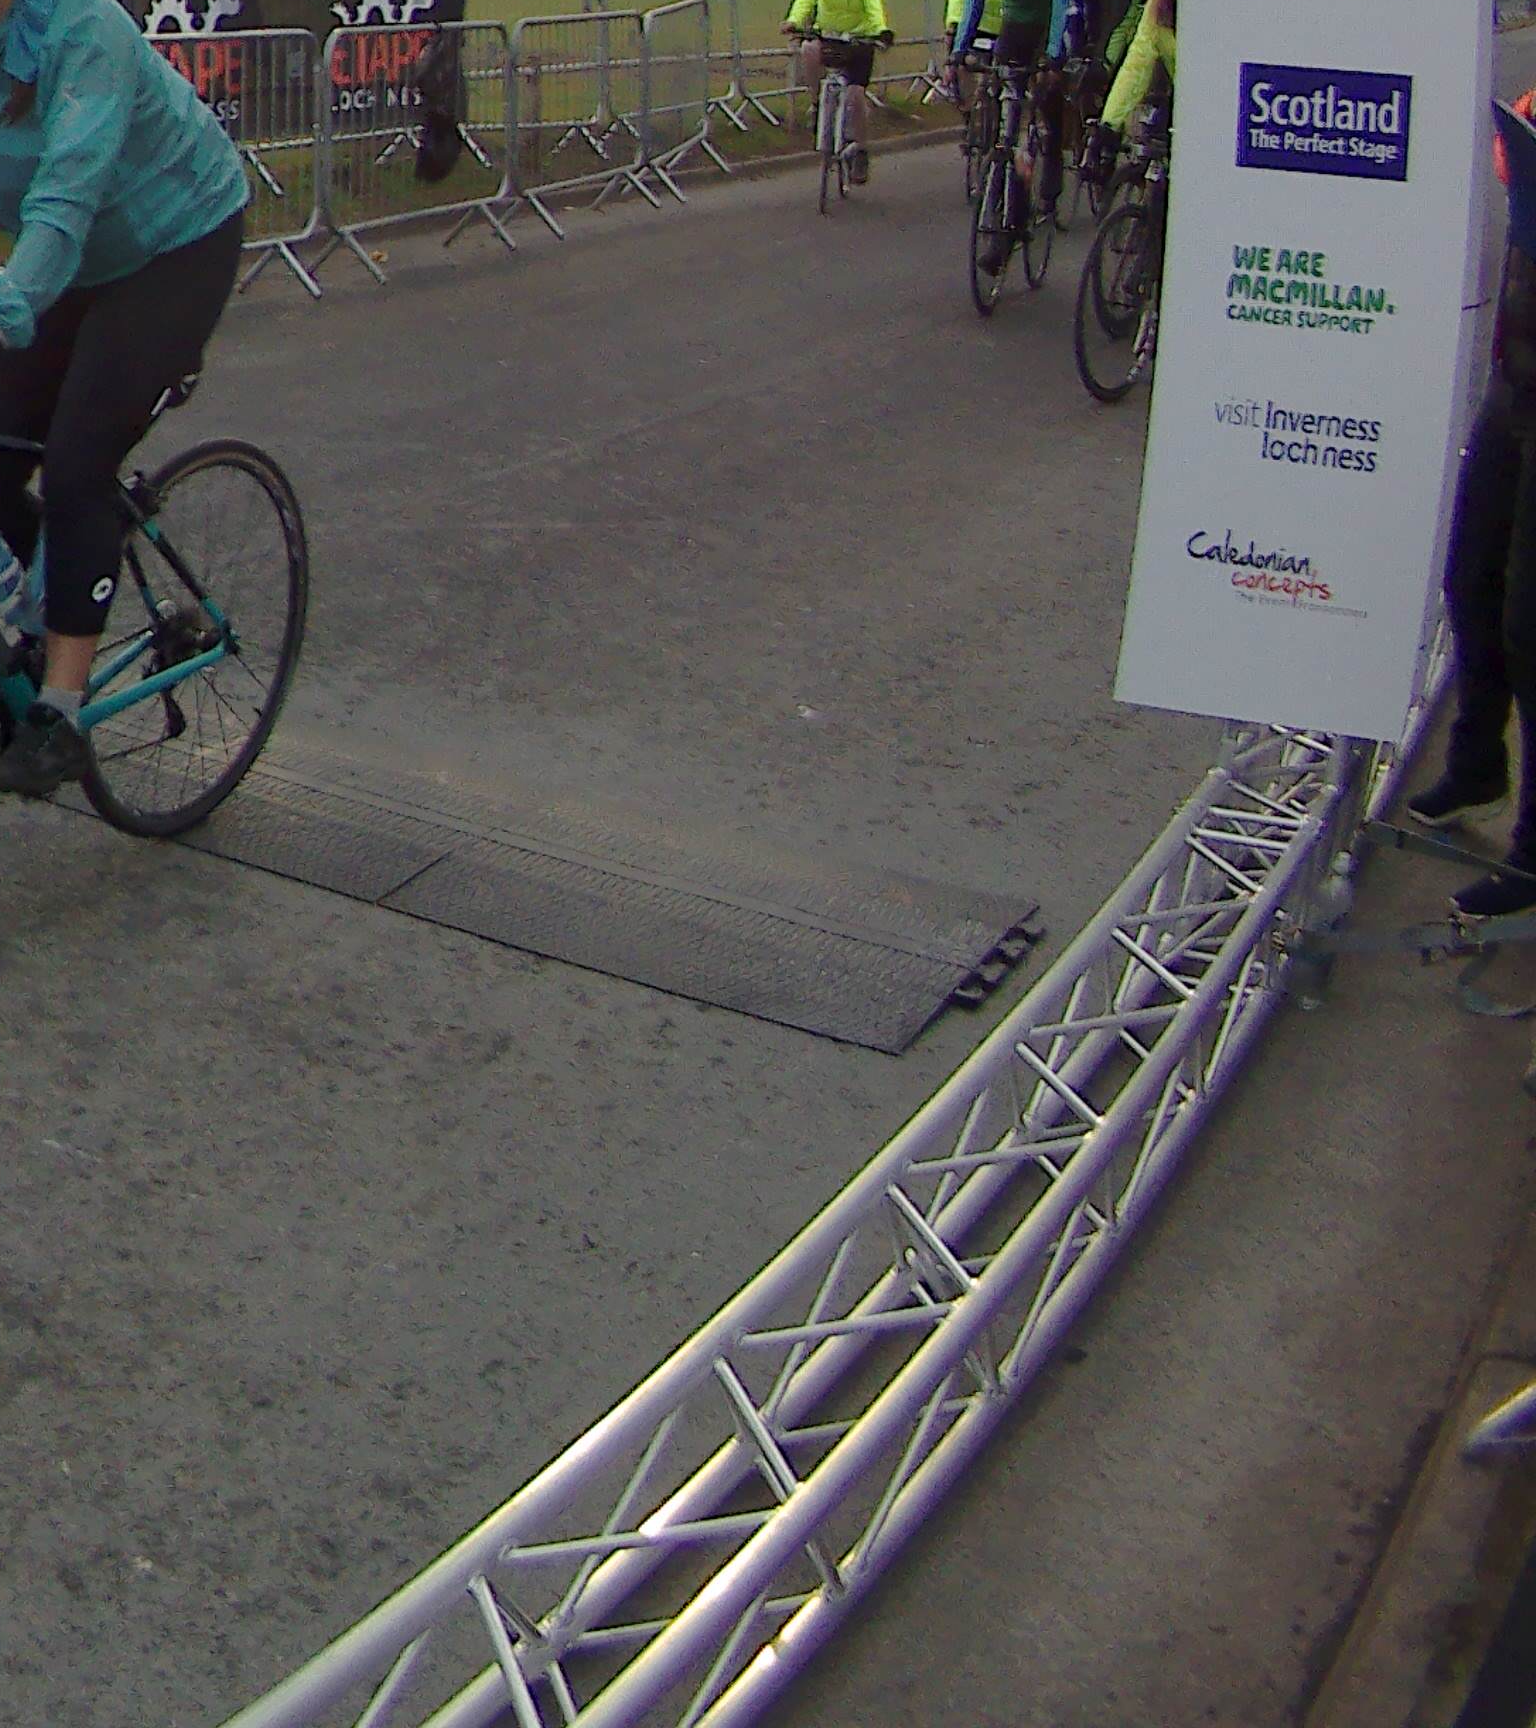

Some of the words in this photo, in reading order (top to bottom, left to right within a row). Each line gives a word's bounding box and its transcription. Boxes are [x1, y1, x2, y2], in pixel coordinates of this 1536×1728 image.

[1250, 80, 1401, 134] Scotland
[1248, 129, 1280, 150] The
[1283, 130, 1345, 157] Perfect
[1348, 136, 1399, 164] Stage
[1233, 244, 1271, 272] WE
[1276, 248, 1327, 277] ARE
[1227, 304, 1293, 327] CANCER
[1297, 310, 1376, 334] SUPPORT
[1215, 396, 1261, 430] visit
[1264, 401, 1382, 443] Inverness
[1261, 432, 1318, 467] loch
[1321, 443, 1378, 473] ness
[1186, 528, 1313, 576] Caledonian
[1231, 570, 1332, 607] concepts
